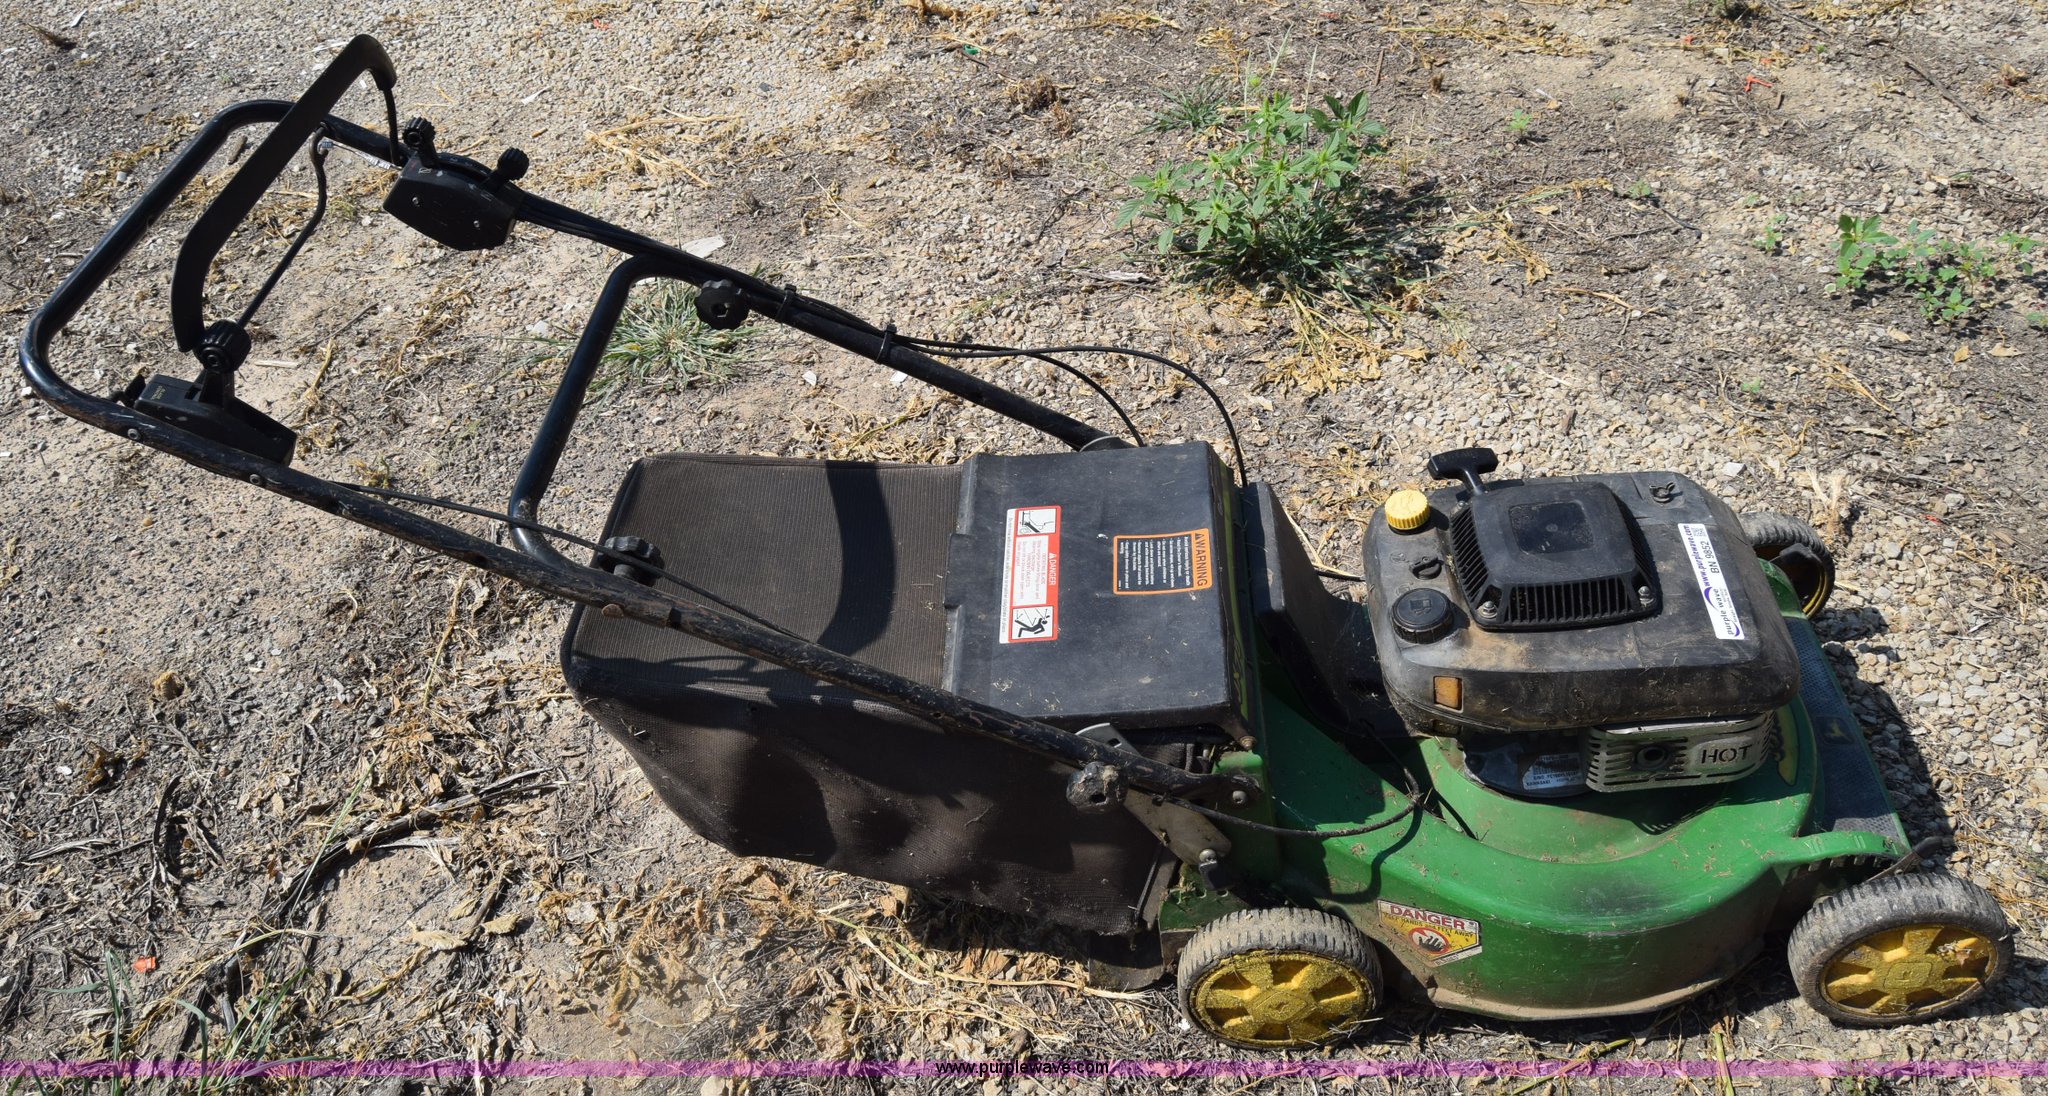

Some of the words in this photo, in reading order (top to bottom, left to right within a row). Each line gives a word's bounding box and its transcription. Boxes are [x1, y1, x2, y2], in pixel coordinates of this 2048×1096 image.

[1684, 525, 1710, 587] www.purplewave.com
[1700, 541, 1714, 558] 9852
[1196, 540, 1208, 586] WARNING
[1708, 561, 1720, 573] BN
[1713, 589, 1724, 608] wave
[1720, 610, 1734, 635] purple
[1701, 744, 1752, 764] HOT
[1390, 905, 1464, 930] DANGER
[1402, 917, 1422, 926] HANDS
[1454, 930, 1473, 938] AWAY
